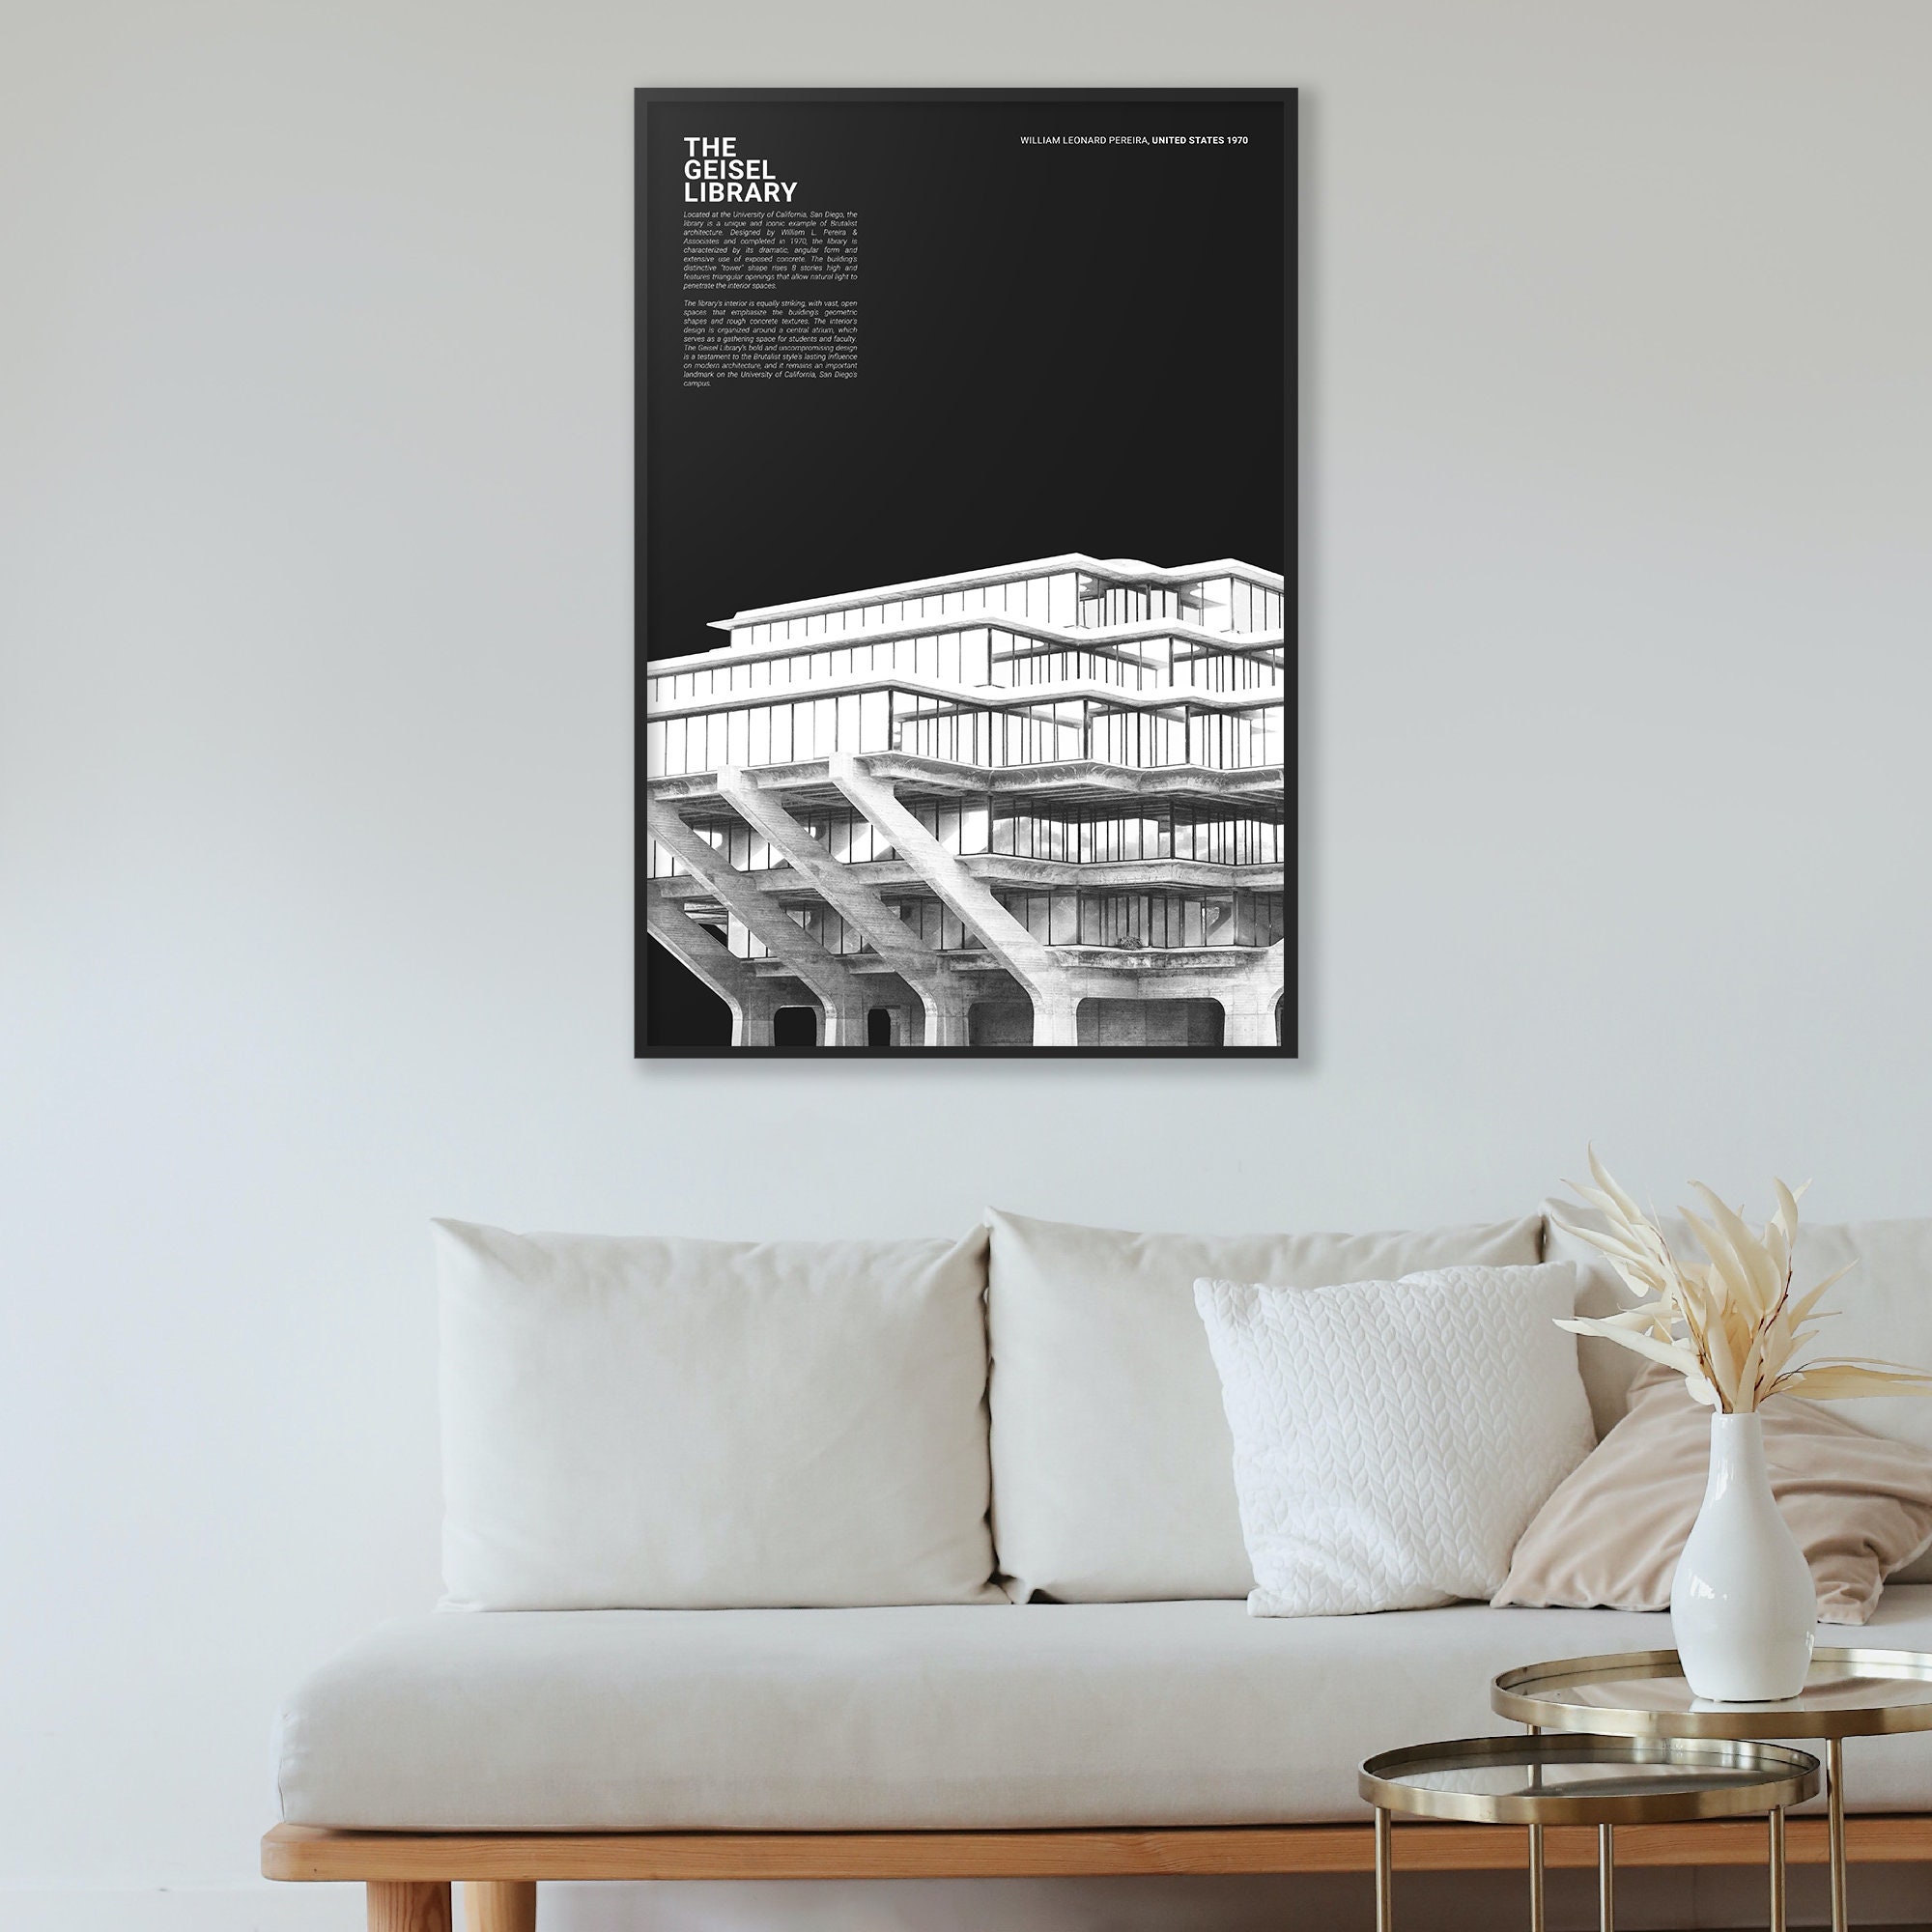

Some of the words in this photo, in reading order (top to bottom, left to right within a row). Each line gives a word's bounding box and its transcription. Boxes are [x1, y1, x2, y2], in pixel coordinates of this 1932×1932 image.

[1020, 136, 1061, 145] WILLIAM
[1063, 136, 1107, 145] LEONARD
[1108, 136, 1151, 146] PEREIRA,
[1151, 136, 1187, 145] UNITED
[1188, 136, 1225, 145] STATES
[1227, 136, 1249, 145] 1970
[683, 137, 737, 156] THE
[684, 159, 776, 180] GEISEL
[685, 182, 798, 202] LIBRARY
[732, 211, 766, 219] University
[729, 228, 761, 237] Designed
[823, 245, 840, 254] form
[733, 254, 742, 263] of
[826, 264, 841, 272] high
[755, 299, 781, 308] equally
[730, 308, 767, 317] emphasize
[778, 334, 787, 343] for
[804, 353, 827, 361] lasting
